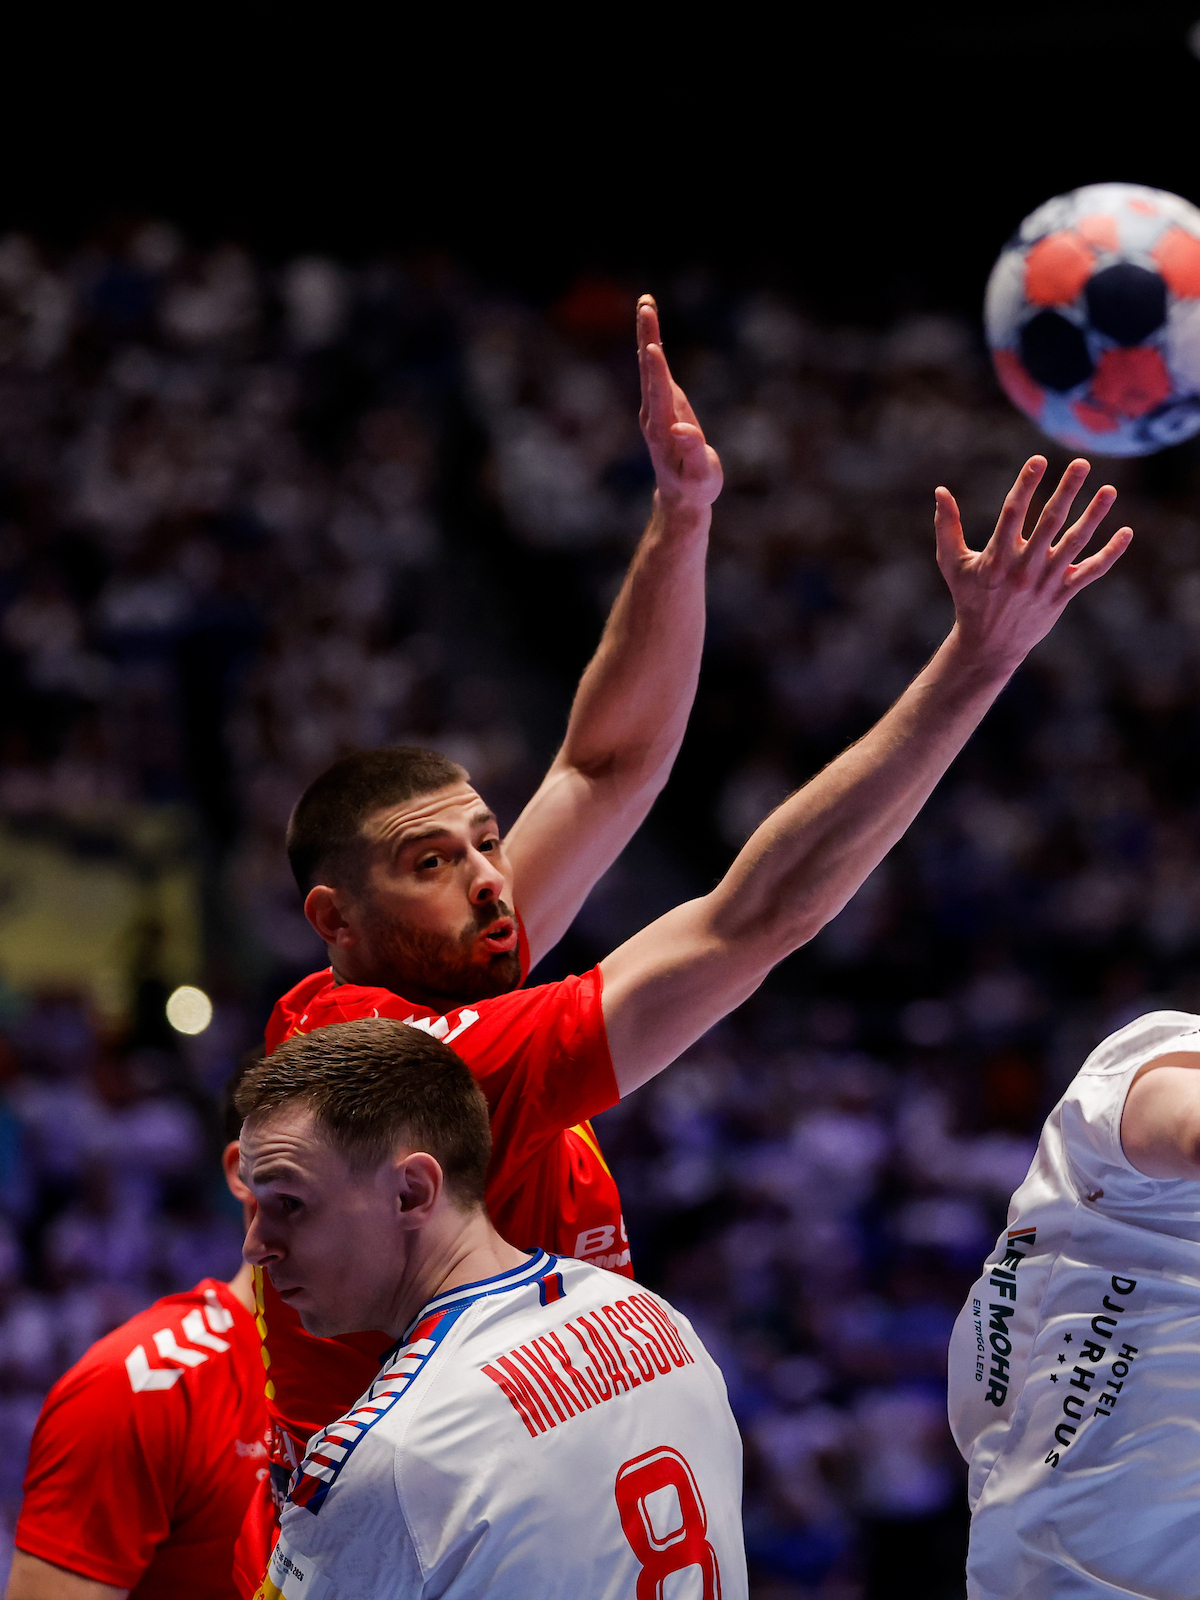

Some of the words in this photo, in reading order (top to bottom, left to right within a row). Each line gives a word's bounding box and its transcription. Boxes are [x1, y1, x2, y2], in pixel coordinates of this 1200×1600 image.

[989, 1233, 1036, 1301] LEIF
[973, 1298, 981, 1318] EIN
[974, 1320, 985, 1352] TRYGG
[480, 1292, 695, 1438] MIKKJALSSON
[975, 1354, 985, 1382] LEID
[984, 1304, 1015, 1408] MOHR
[1044, 1275, 1137, 1468] DJURHUUS
[1093, 1343, 1139, 1418] HOTEL
[615, 1445, 722, 1600] 8
